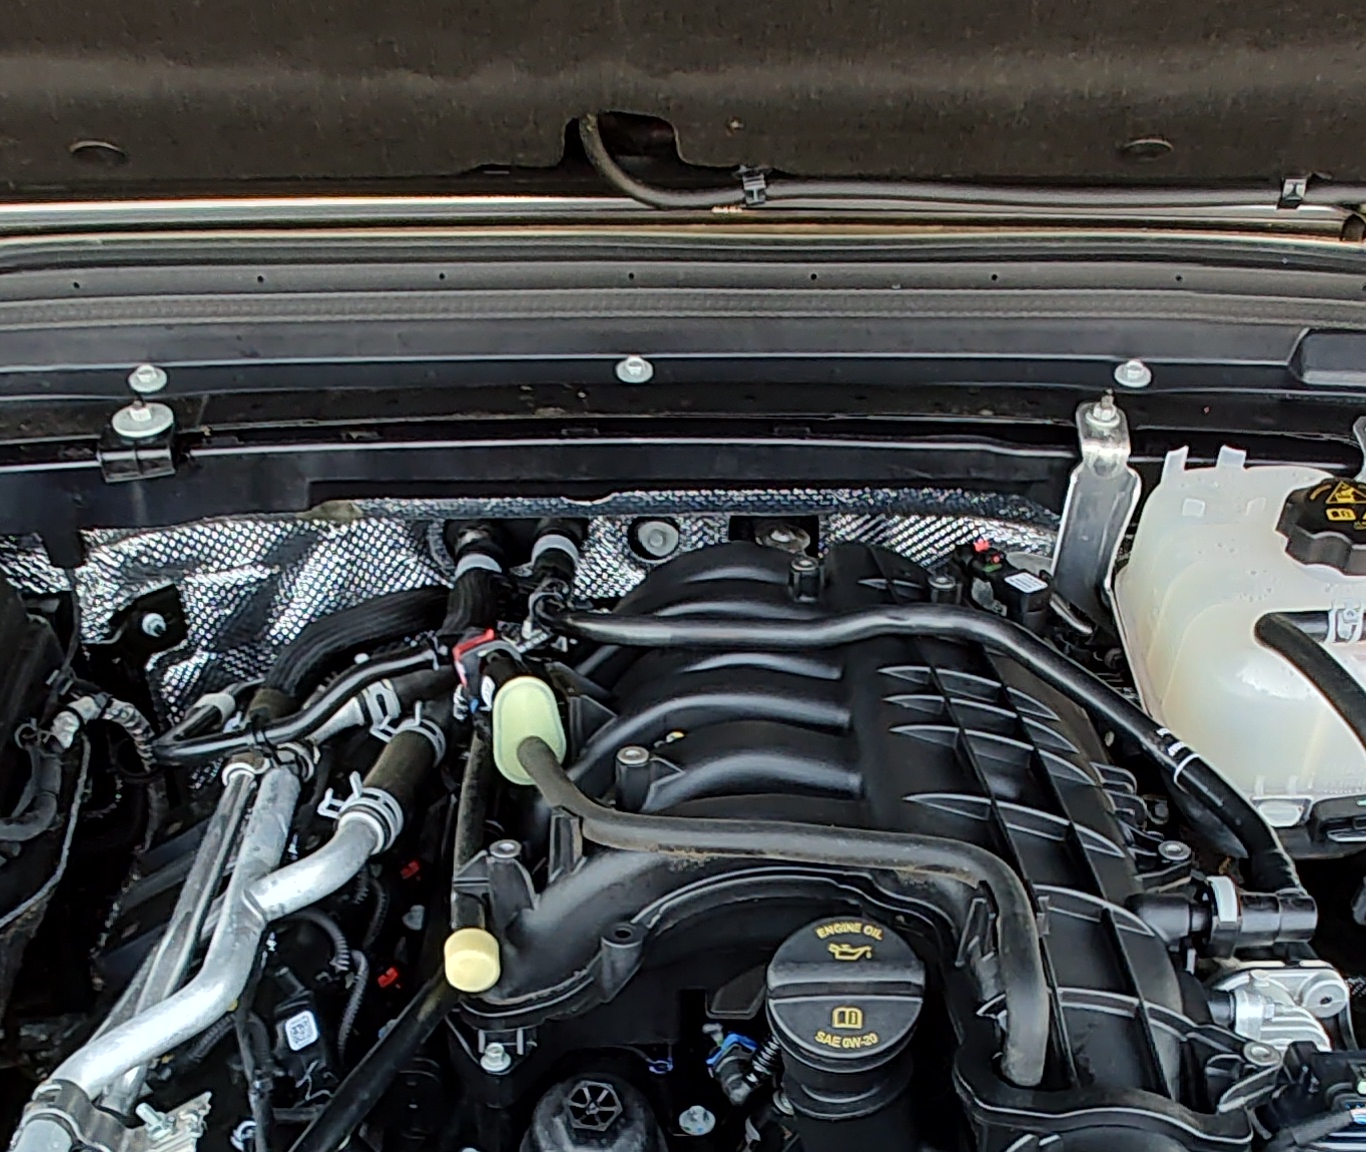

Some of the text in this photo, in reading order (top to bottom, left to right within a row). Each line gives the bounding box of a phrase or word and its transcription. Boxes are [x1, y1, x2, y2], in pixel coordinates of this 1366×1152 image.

[816, 922, 883, 940] ENGINE OIL
[815, 1031, 878, 1048] SAE 0W-20
